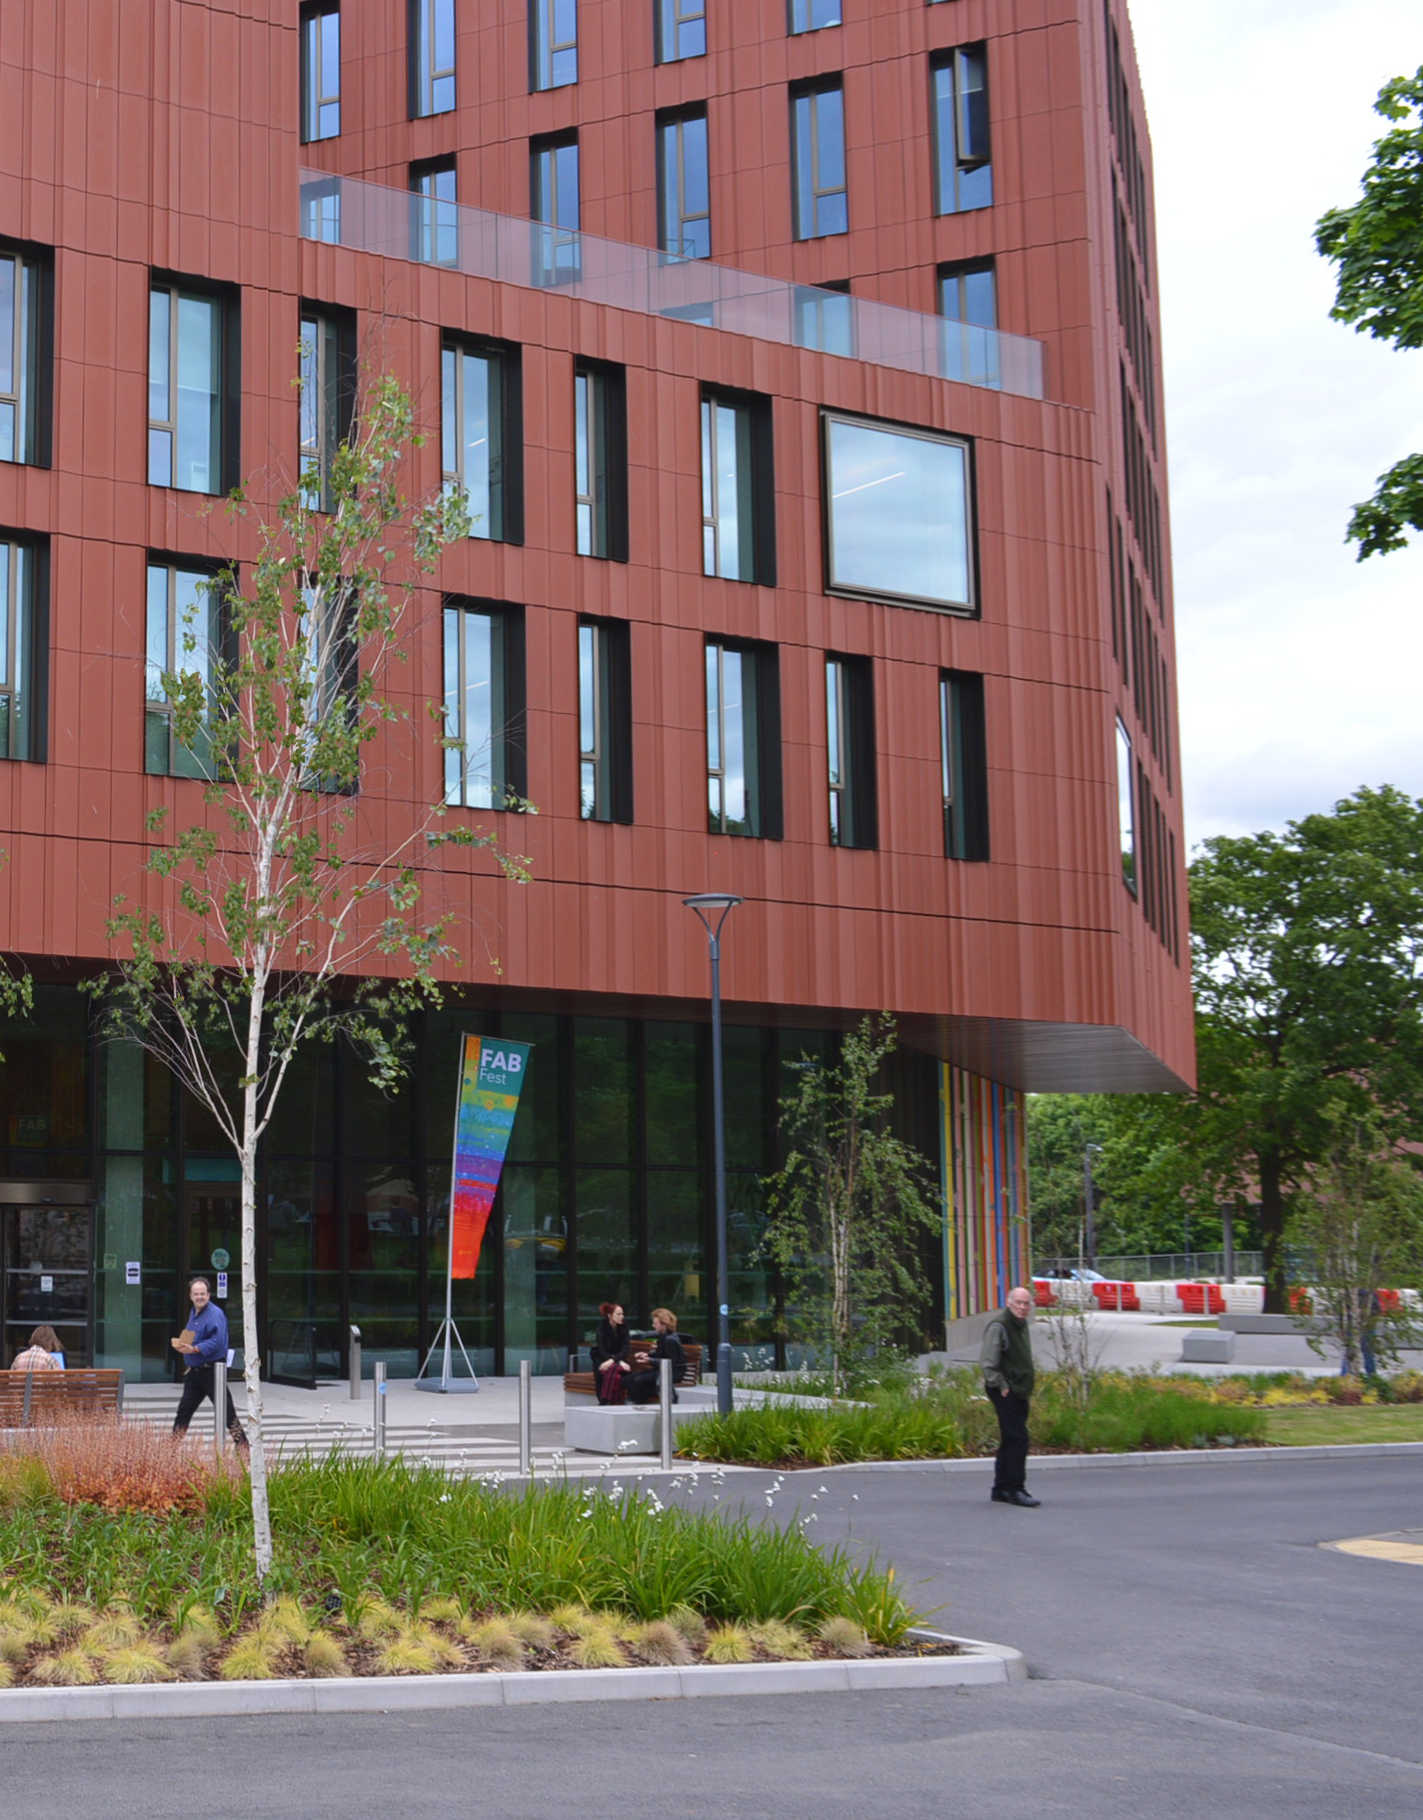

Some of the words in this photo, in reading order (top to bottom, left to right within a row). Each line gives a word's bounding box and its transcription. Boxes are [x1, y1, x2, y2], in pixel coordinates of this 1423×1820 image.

[480, 1048, 522, 1073] FAB
[479, 1067, 507, 1085] Fest
[18, 1118, 46, 1131] FAB
